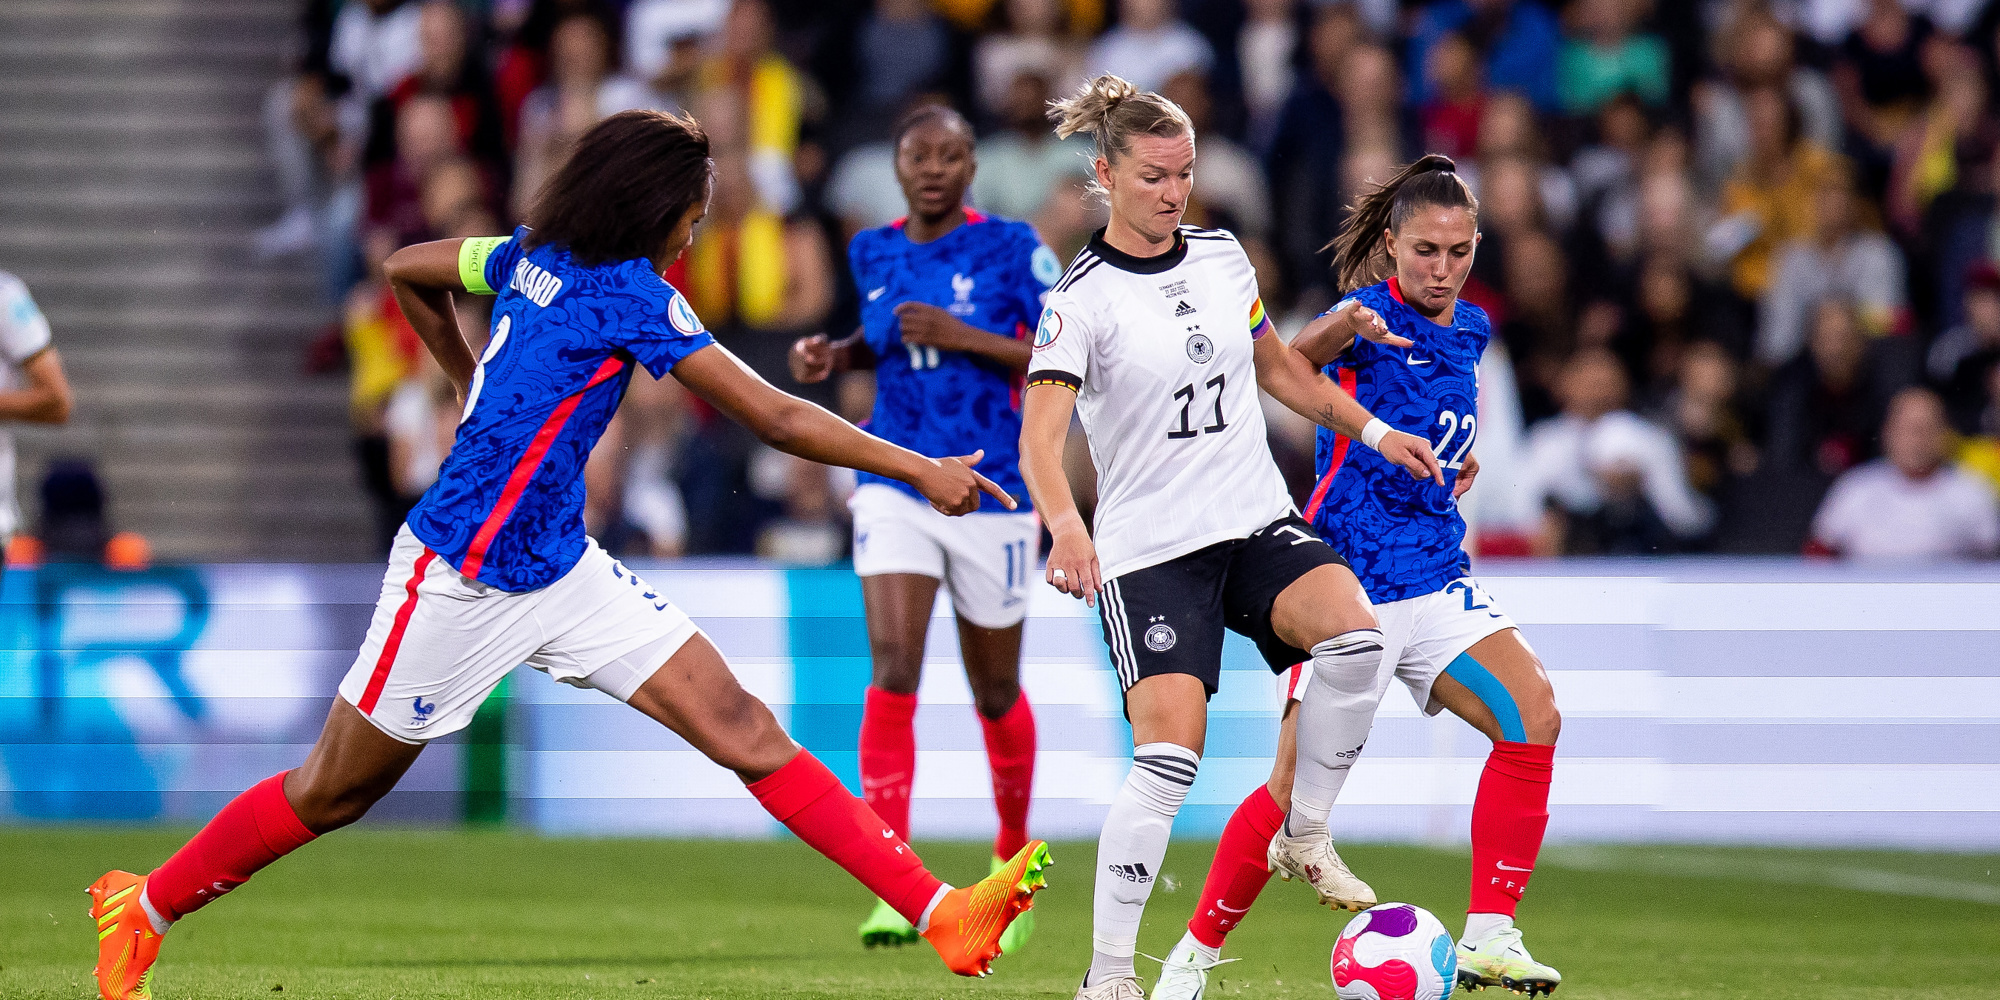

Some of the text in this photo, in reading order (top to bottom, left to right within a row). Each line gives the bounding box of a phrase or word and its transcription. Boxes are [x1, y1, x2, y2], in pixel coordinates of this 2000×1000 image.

[1168, 373, 1229, 439] 11
[1433, 410, 1476, 470] 22
[1273, 525, 1325, 546] 1
[1003, 539, 1026, 588] 11
[1109, 864, 1153, 883] adidas
